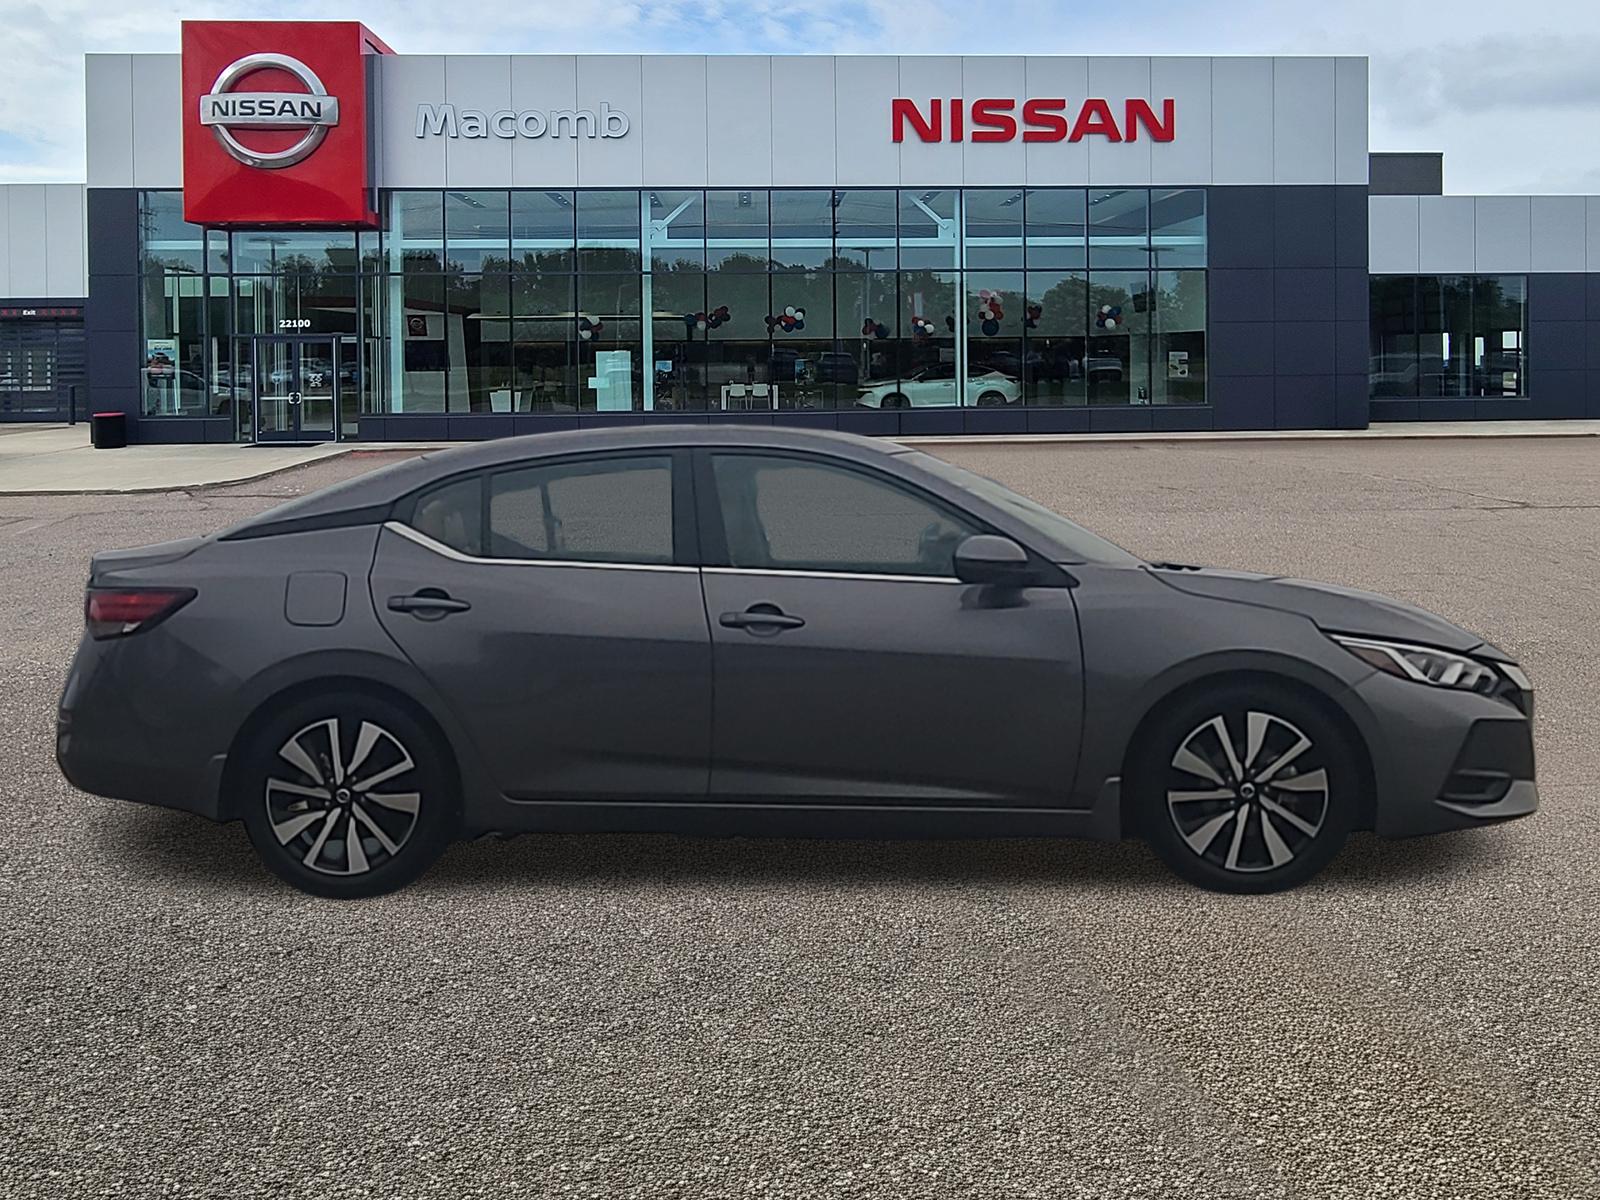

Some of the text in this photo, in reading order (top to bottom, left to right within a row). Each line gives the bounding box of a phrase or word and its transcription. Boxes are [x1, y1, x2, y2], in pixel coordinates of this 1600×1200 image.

[212, 100, 322, 117] NISSAN
[415, 102, 630, 139] Macomb
[892, 98, 1175, 143] NISSAN
[279, 319, 311, 328] 22100
